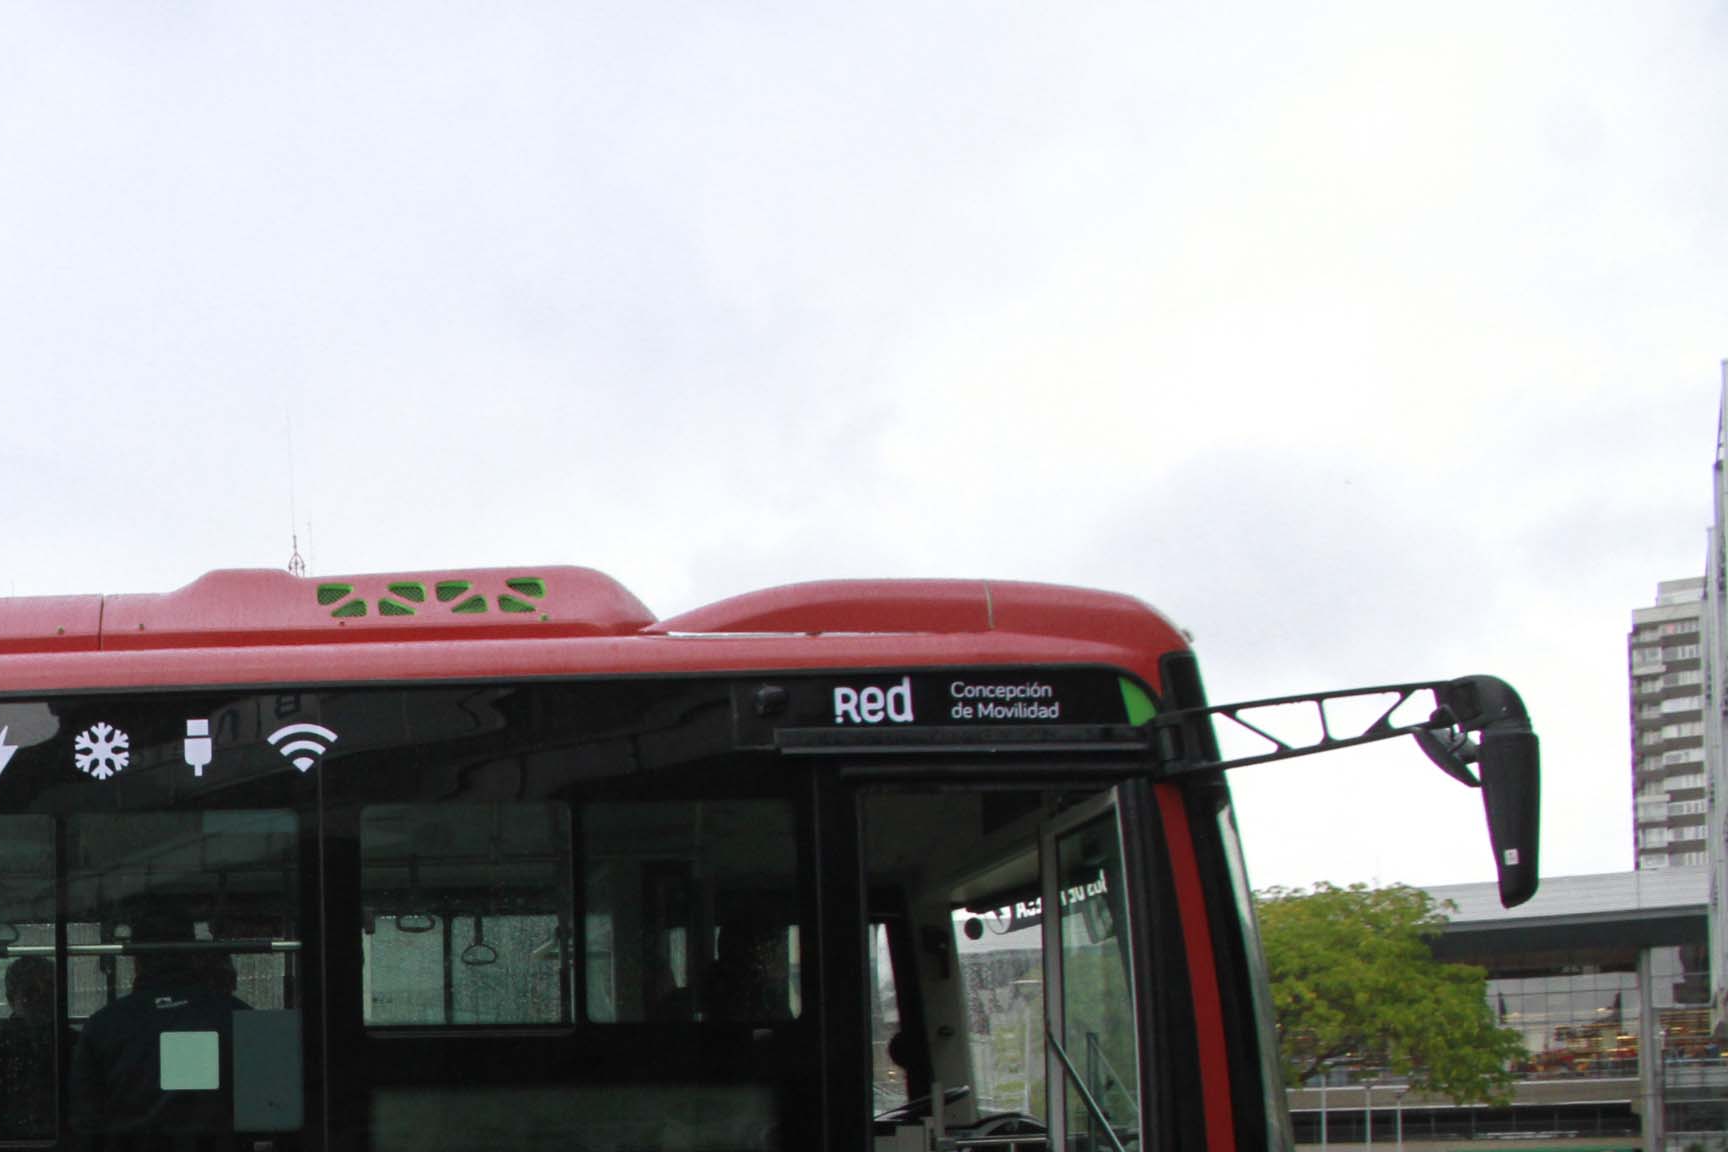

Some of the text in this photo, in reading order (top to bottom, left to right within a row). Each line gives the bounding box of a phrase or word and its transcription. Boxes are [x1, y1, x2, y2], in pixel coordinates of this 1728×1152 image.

[833, 675, 914, 724] Red
[950, 681, 1053, 701] Concepción
[951, 701, 1060, 719] de Movilidad
